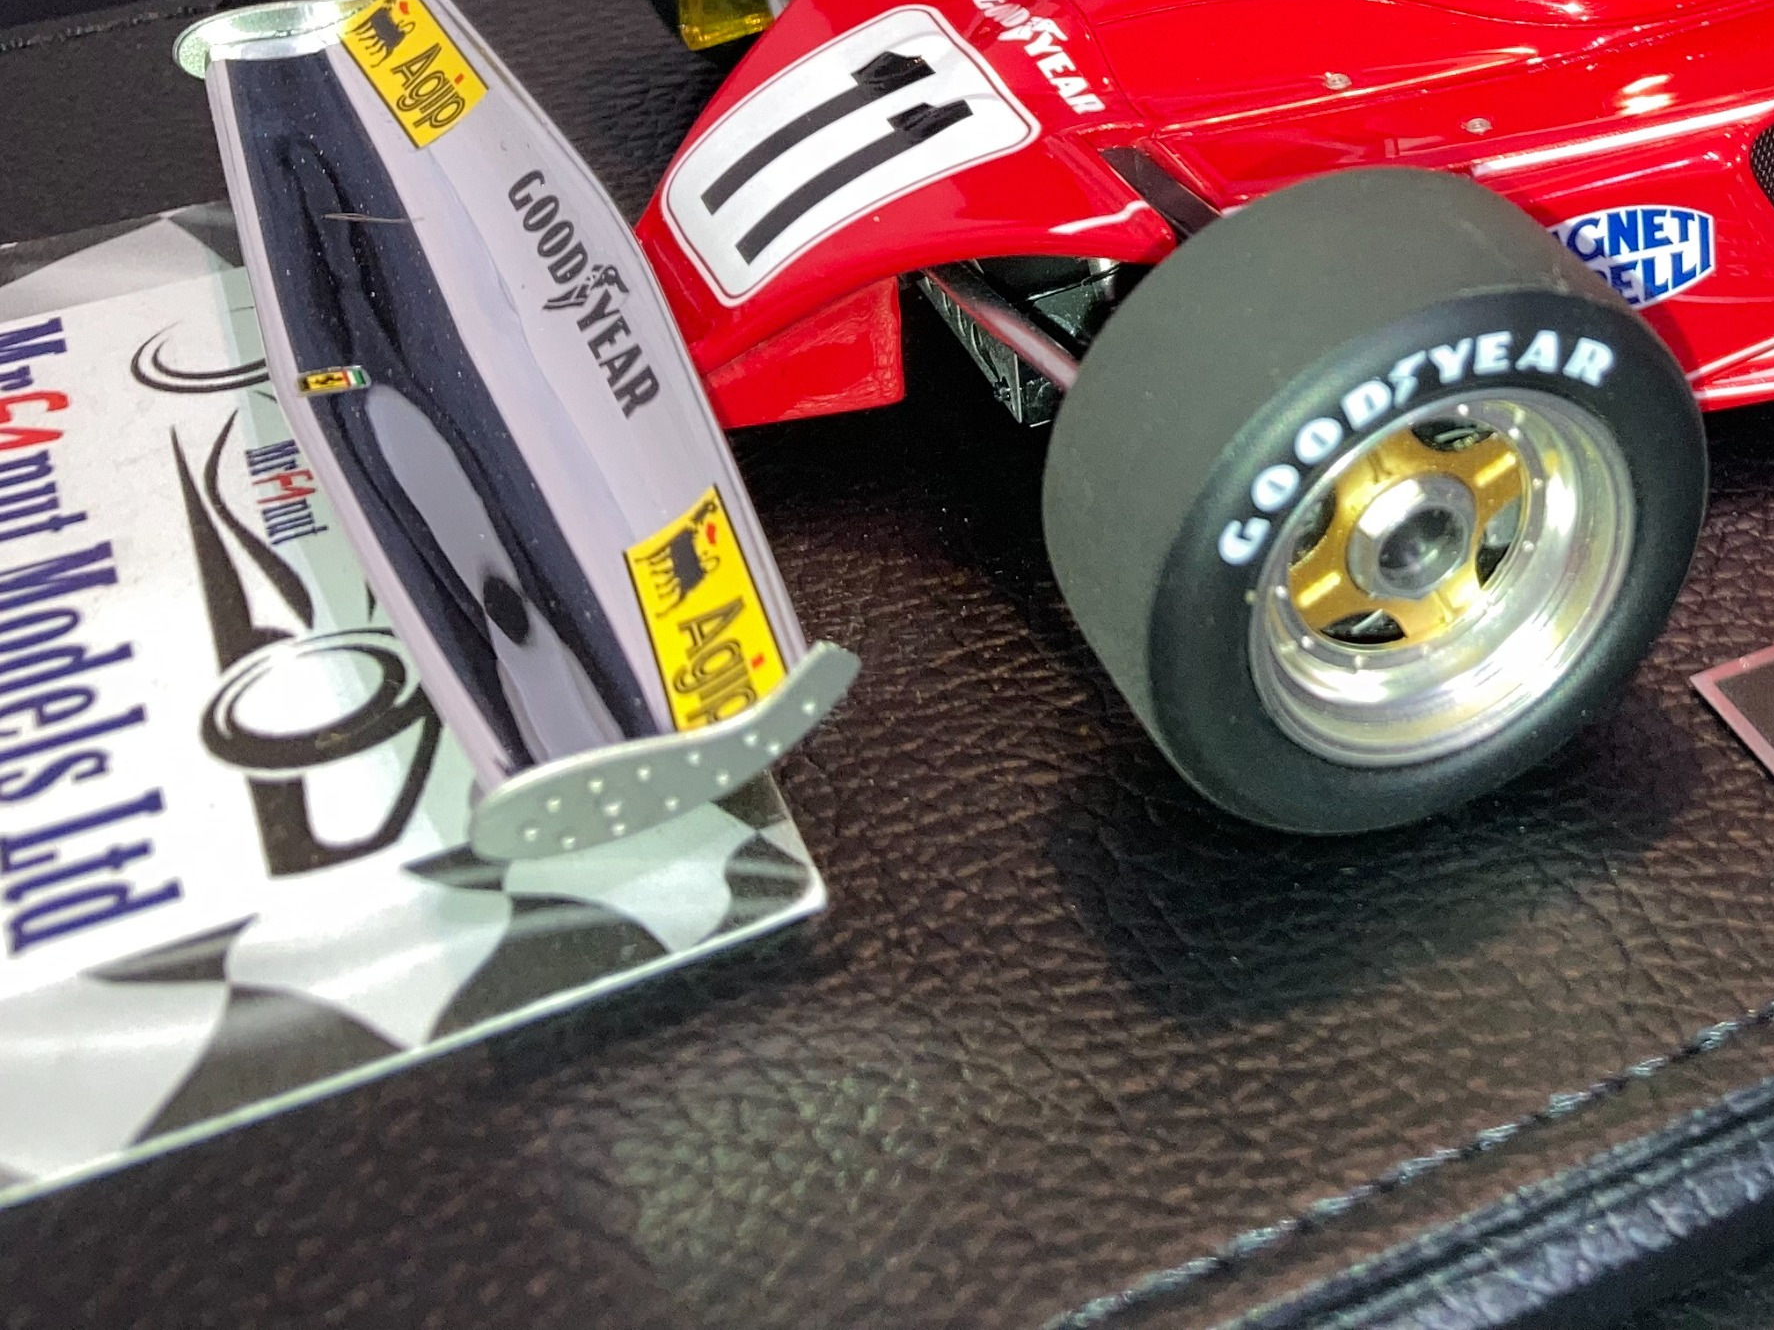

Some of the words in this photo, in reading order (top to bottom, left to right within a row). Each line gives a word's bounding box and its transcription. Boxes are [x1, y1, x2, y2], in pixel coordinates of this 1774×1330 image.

[390, 42, 466, 129] Agip
[700, 50, 974, 266] 11
[1552, 208, 1711, 269] GNETI
[0, 538, 148, 803] Models
[673, 596, 765, 722] Agip
[0, 787, 183, 954] Ltd
